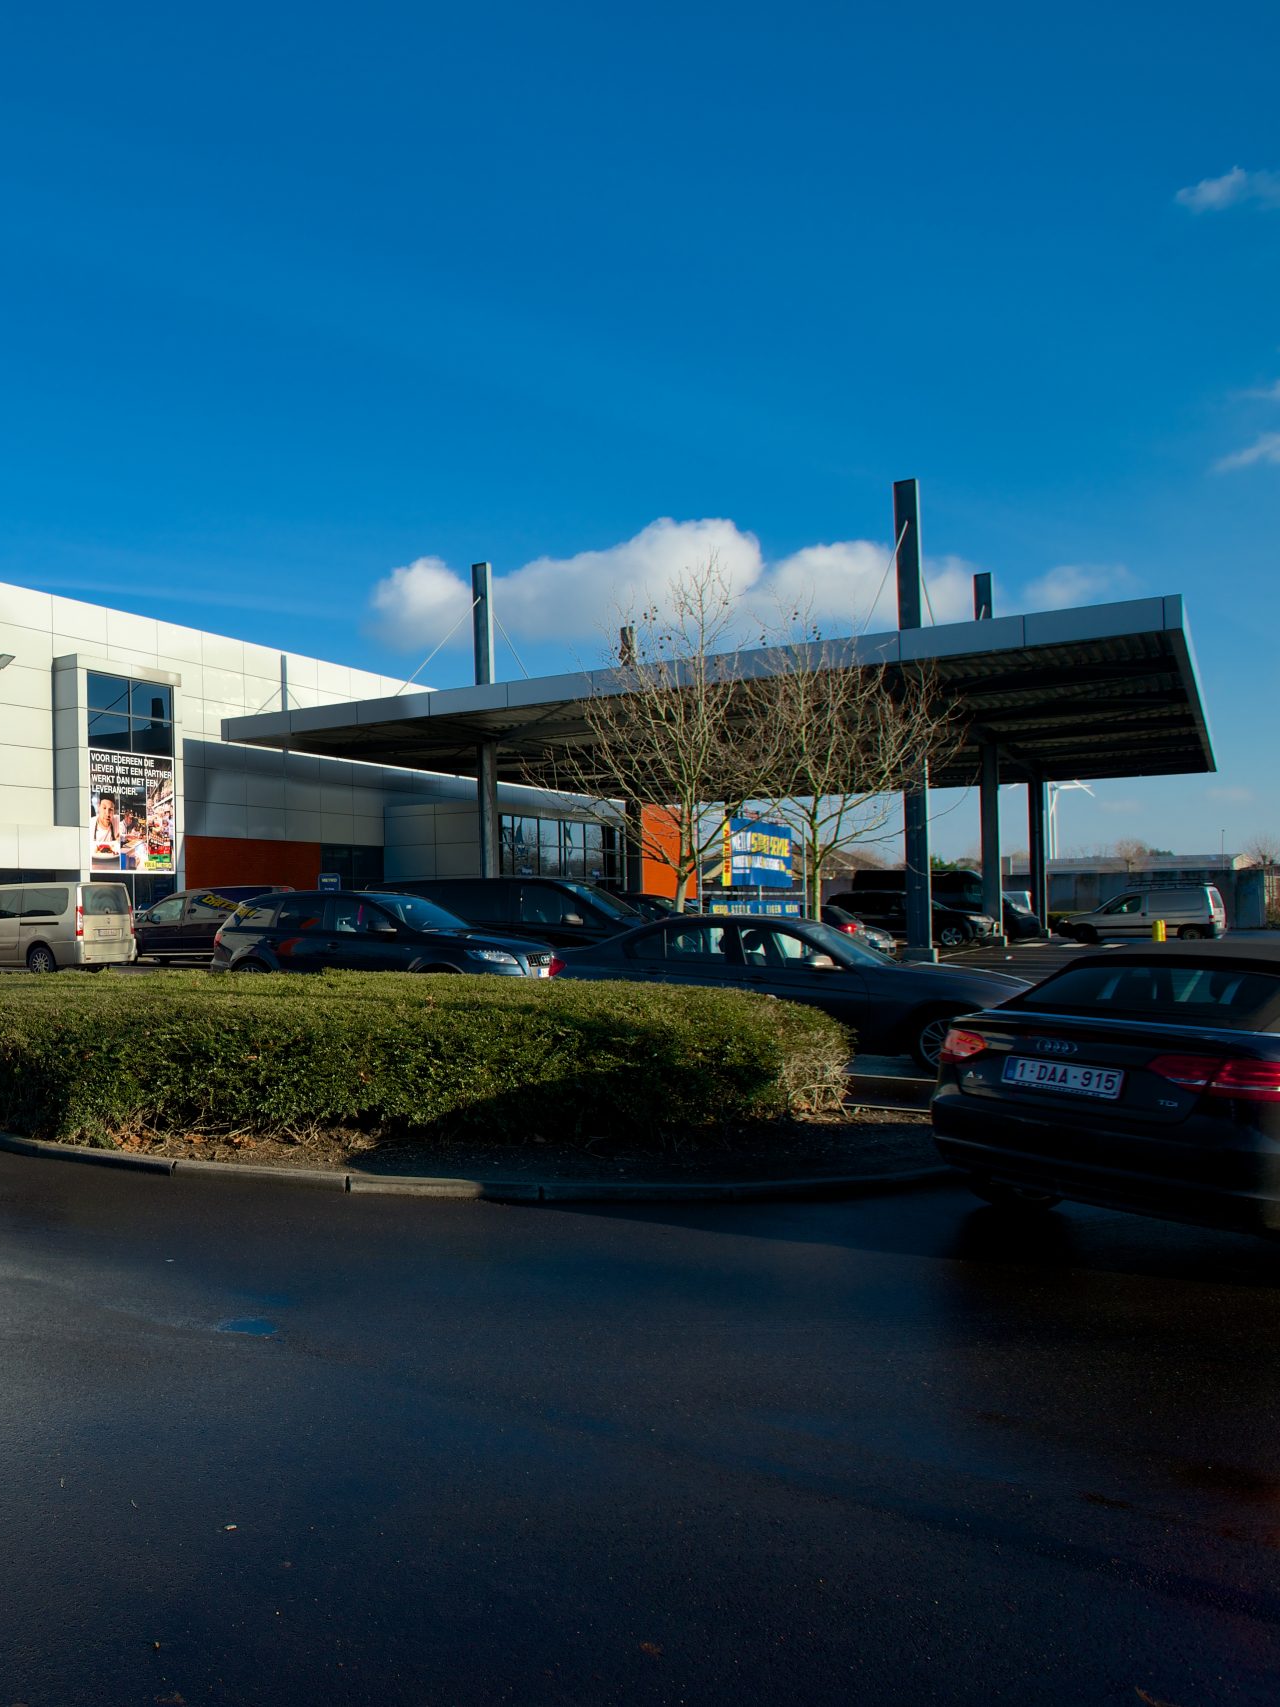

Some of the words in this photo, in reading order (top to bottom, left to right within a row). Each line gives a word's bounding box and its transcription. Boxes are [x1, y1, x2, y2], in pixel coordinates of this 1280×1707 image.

[91, 753, 110, 763] VOOR
[111, 755, 143, 766] IEDEREEN
[144, 759, 155, 768] DIE
[91, 763, 114, 774] LIEVER
[115, 766, 130, 775] MET
[130, 767, 143, 777] EEN
[144, 769, 172, 779] PARTNER
[91, 774, 115, 784] WERKT
[116, 776, 130, 785] DAN
[131, 778, 145, 787] MET
[146, 779, 159, 788] EEN
[91, 784, 139, 796] LEVERANCIER.
[1019, 1063, 1117, 1090] 1-DAA-915
[1157, 1099, 1179, 1108] TDI
